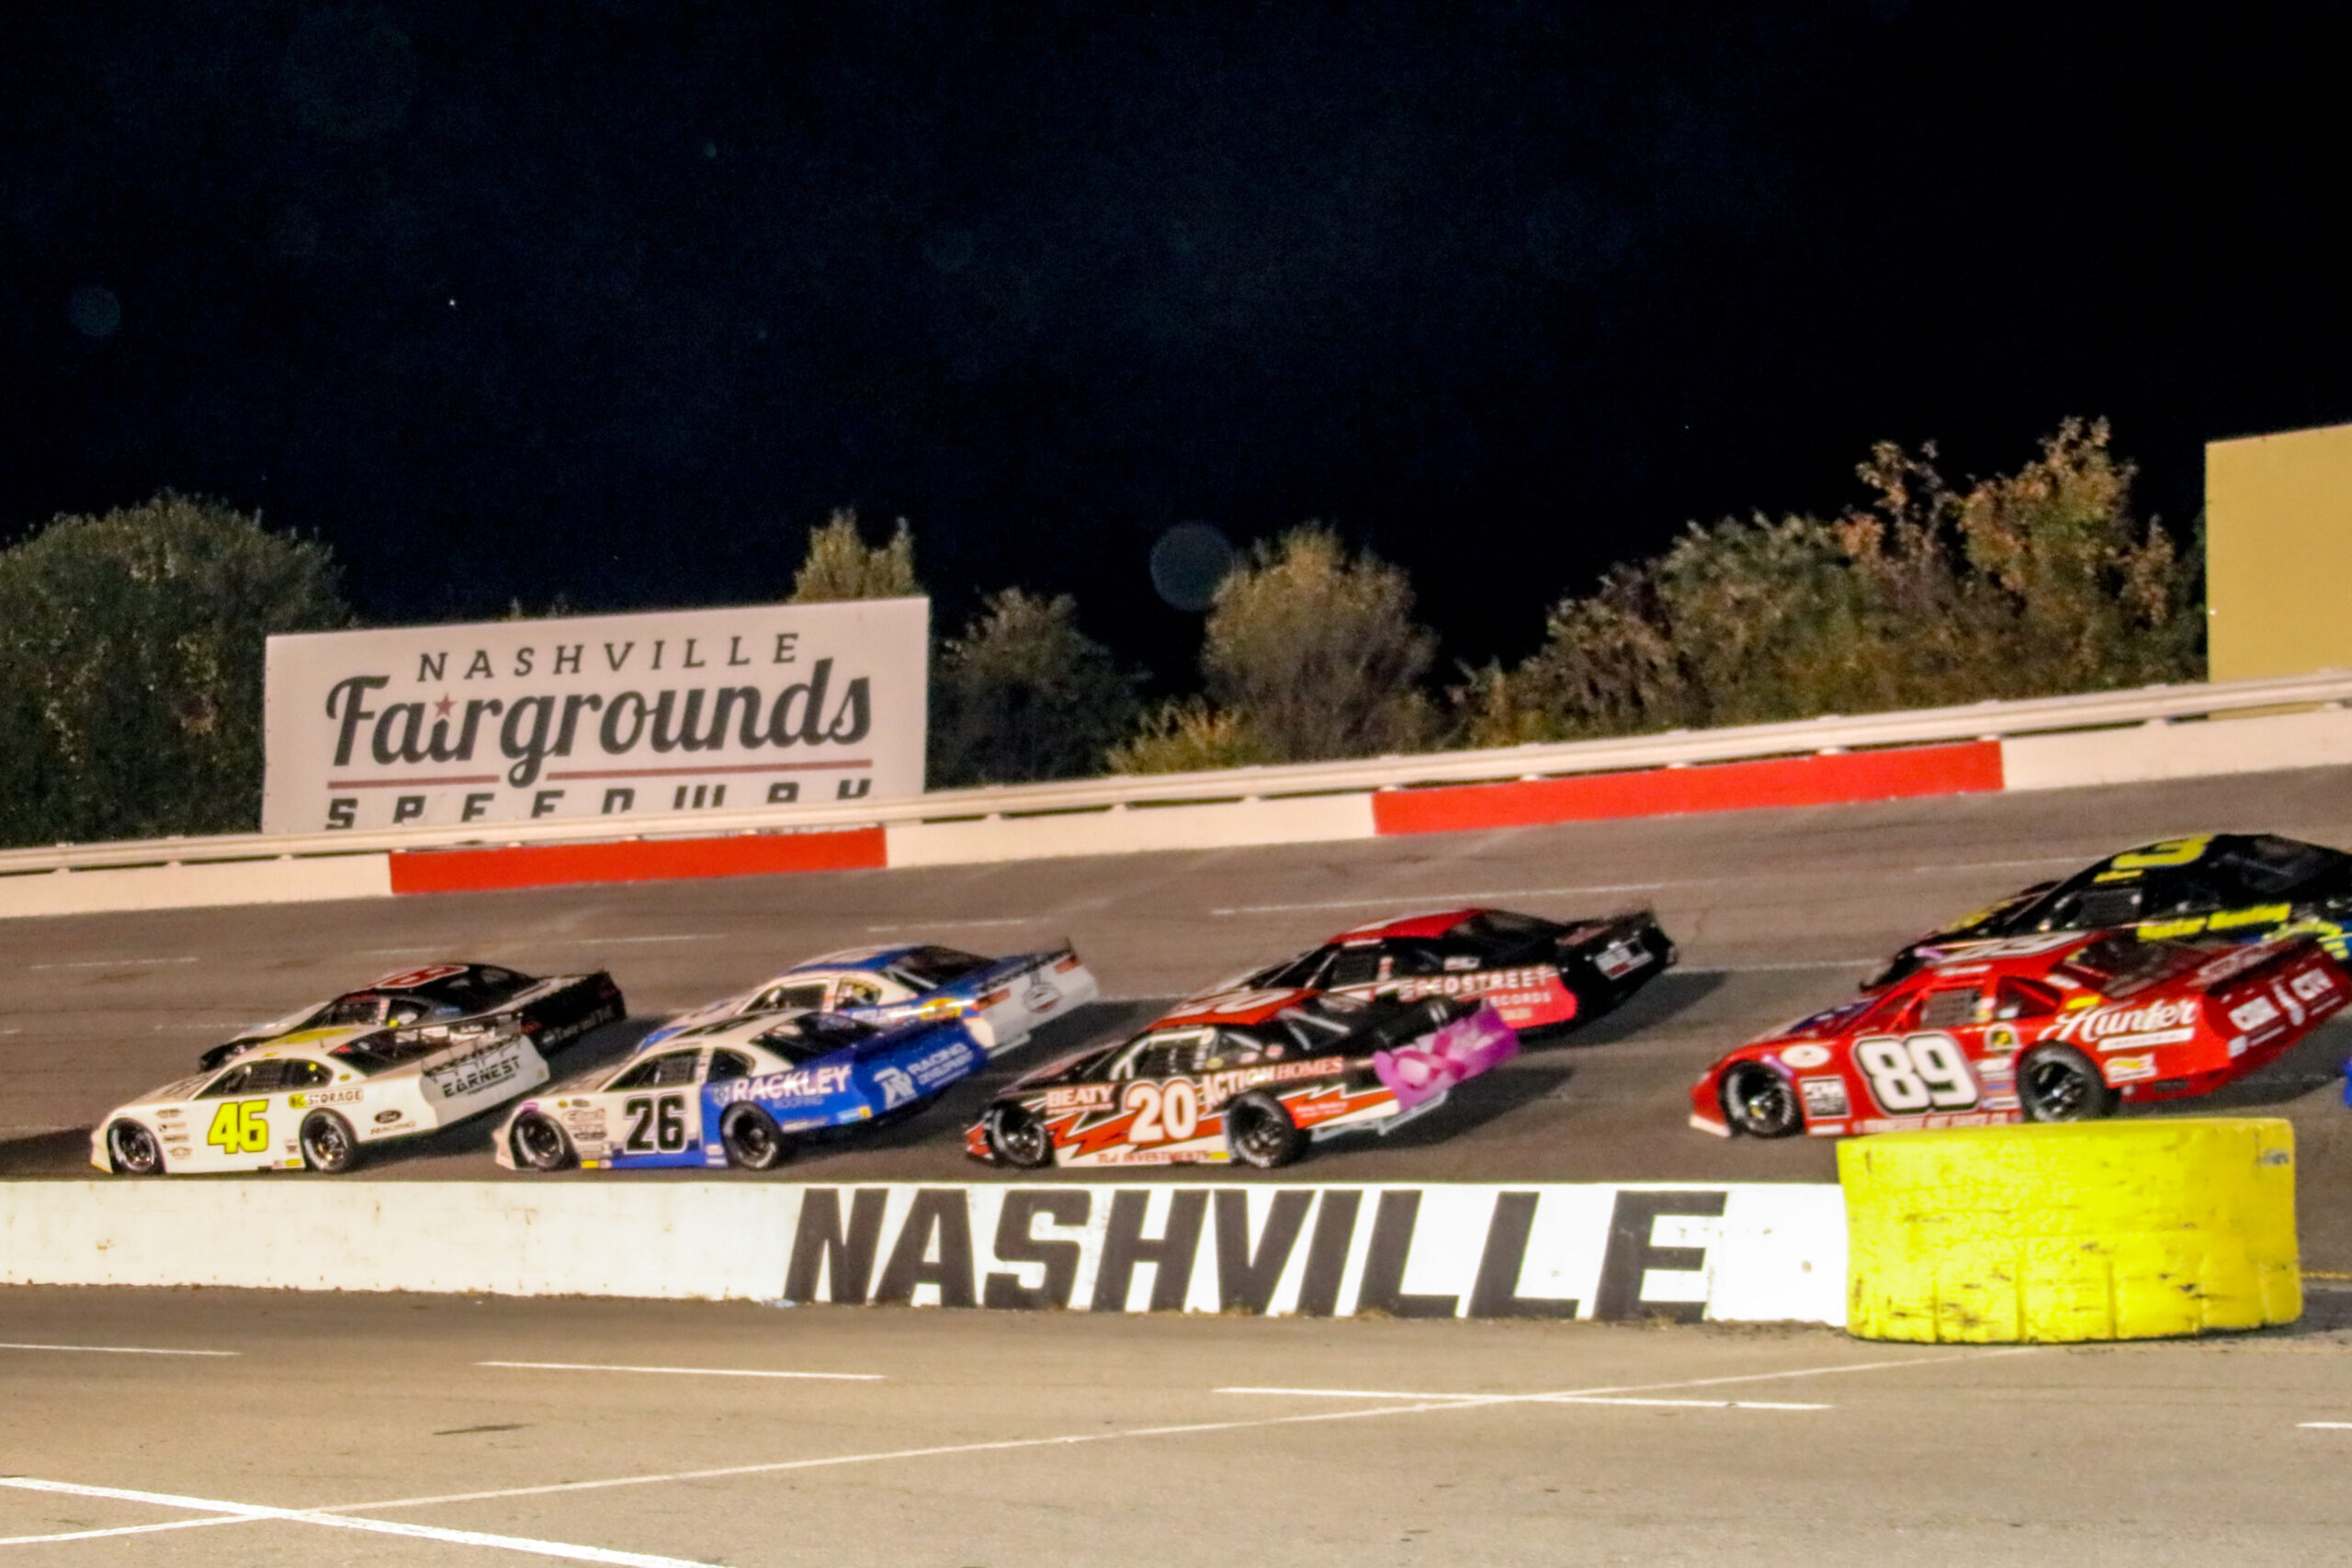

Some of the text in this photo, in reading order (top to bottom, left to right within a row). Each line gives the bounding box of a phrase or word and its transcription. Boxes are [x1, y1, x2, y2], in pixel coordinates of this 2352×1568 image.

[416, 634, 799, 682] NASHVILLE
[325, 657, 871, 788] Fairgrounds
[1487, 991, 1551, 1007] ECORDS
[2038, 998, 2197, 1043] Hunter
[442, 1055, 521, 1098] EARNEST
[732, 1064, 852, 1102] RACKLEY
[1274, 1056, 1343, 1081] HOMES
[1854, 1032, 1980, 1115] 89
[307, 1089, 361, 1105] STORAGE
[1046, 1083, 1117, 1109] BEATY
[1122, 1077, 1197, 1143] 20
[208, 1099, 270, 1155] 46
[625, 1091, 688, 1155] 26
[785, 1188, 1729, 1325] NASHVILLE
